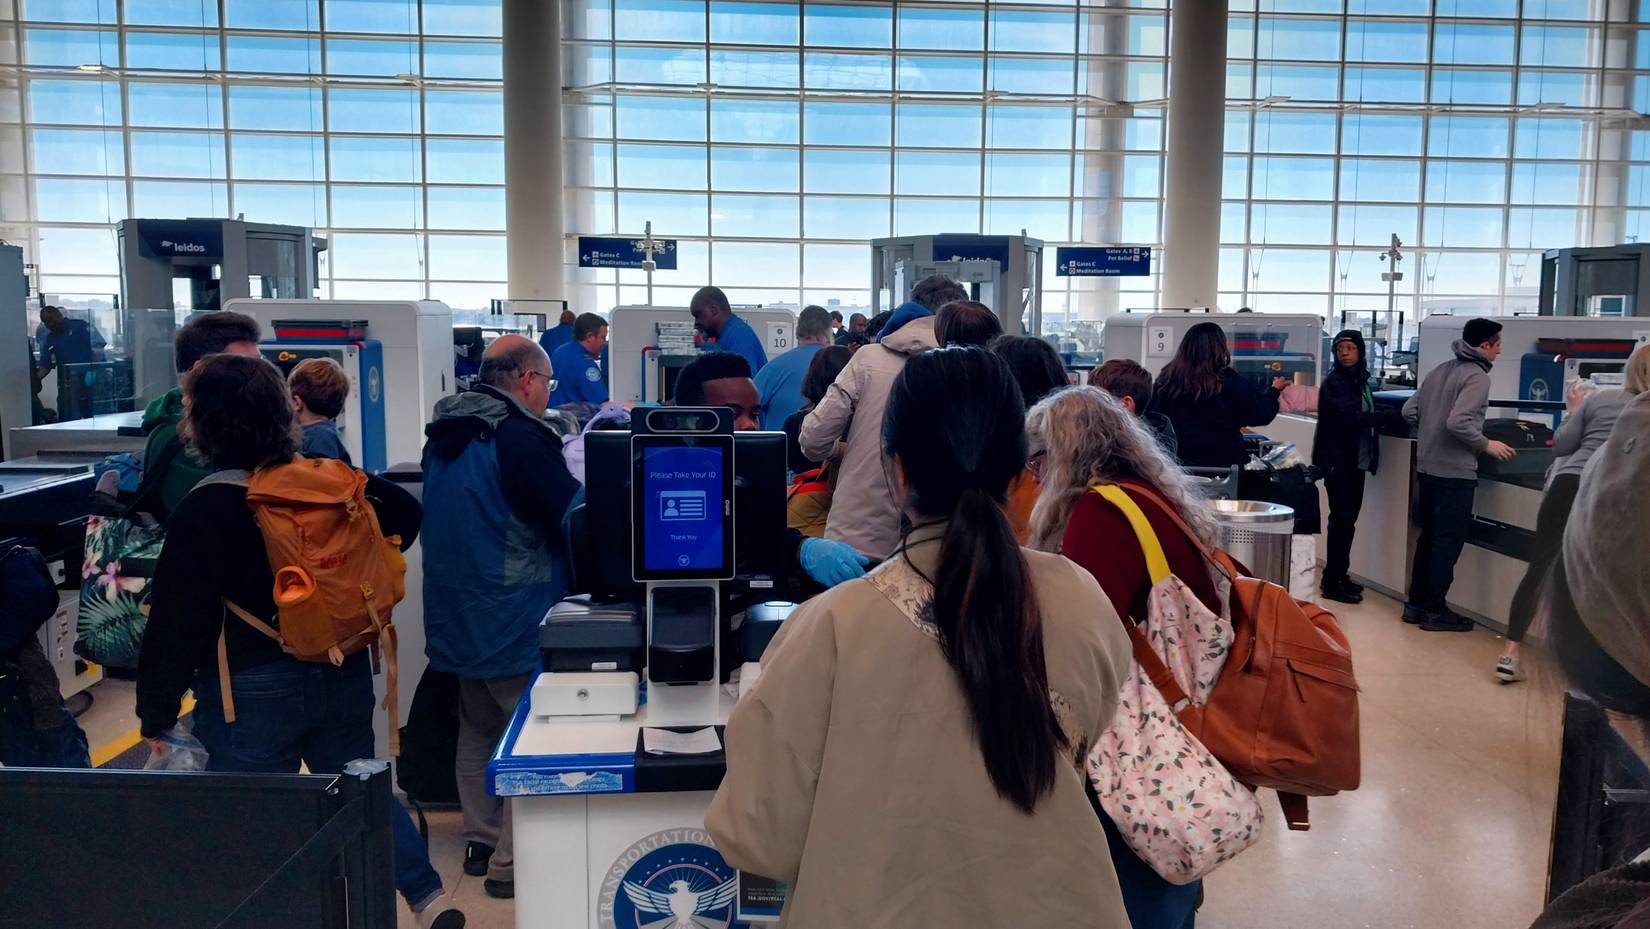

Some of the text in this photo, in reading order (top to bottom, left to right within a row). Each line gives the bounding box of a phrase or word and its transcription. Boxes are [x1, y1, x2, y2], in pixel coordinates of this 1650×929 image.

[174, 242, 205, 252] leidos
[774, 338, 787, 348] 10
[1157, 342, 1165, 352] 9
[650, 471, 717, 479] Please Take Your ID
